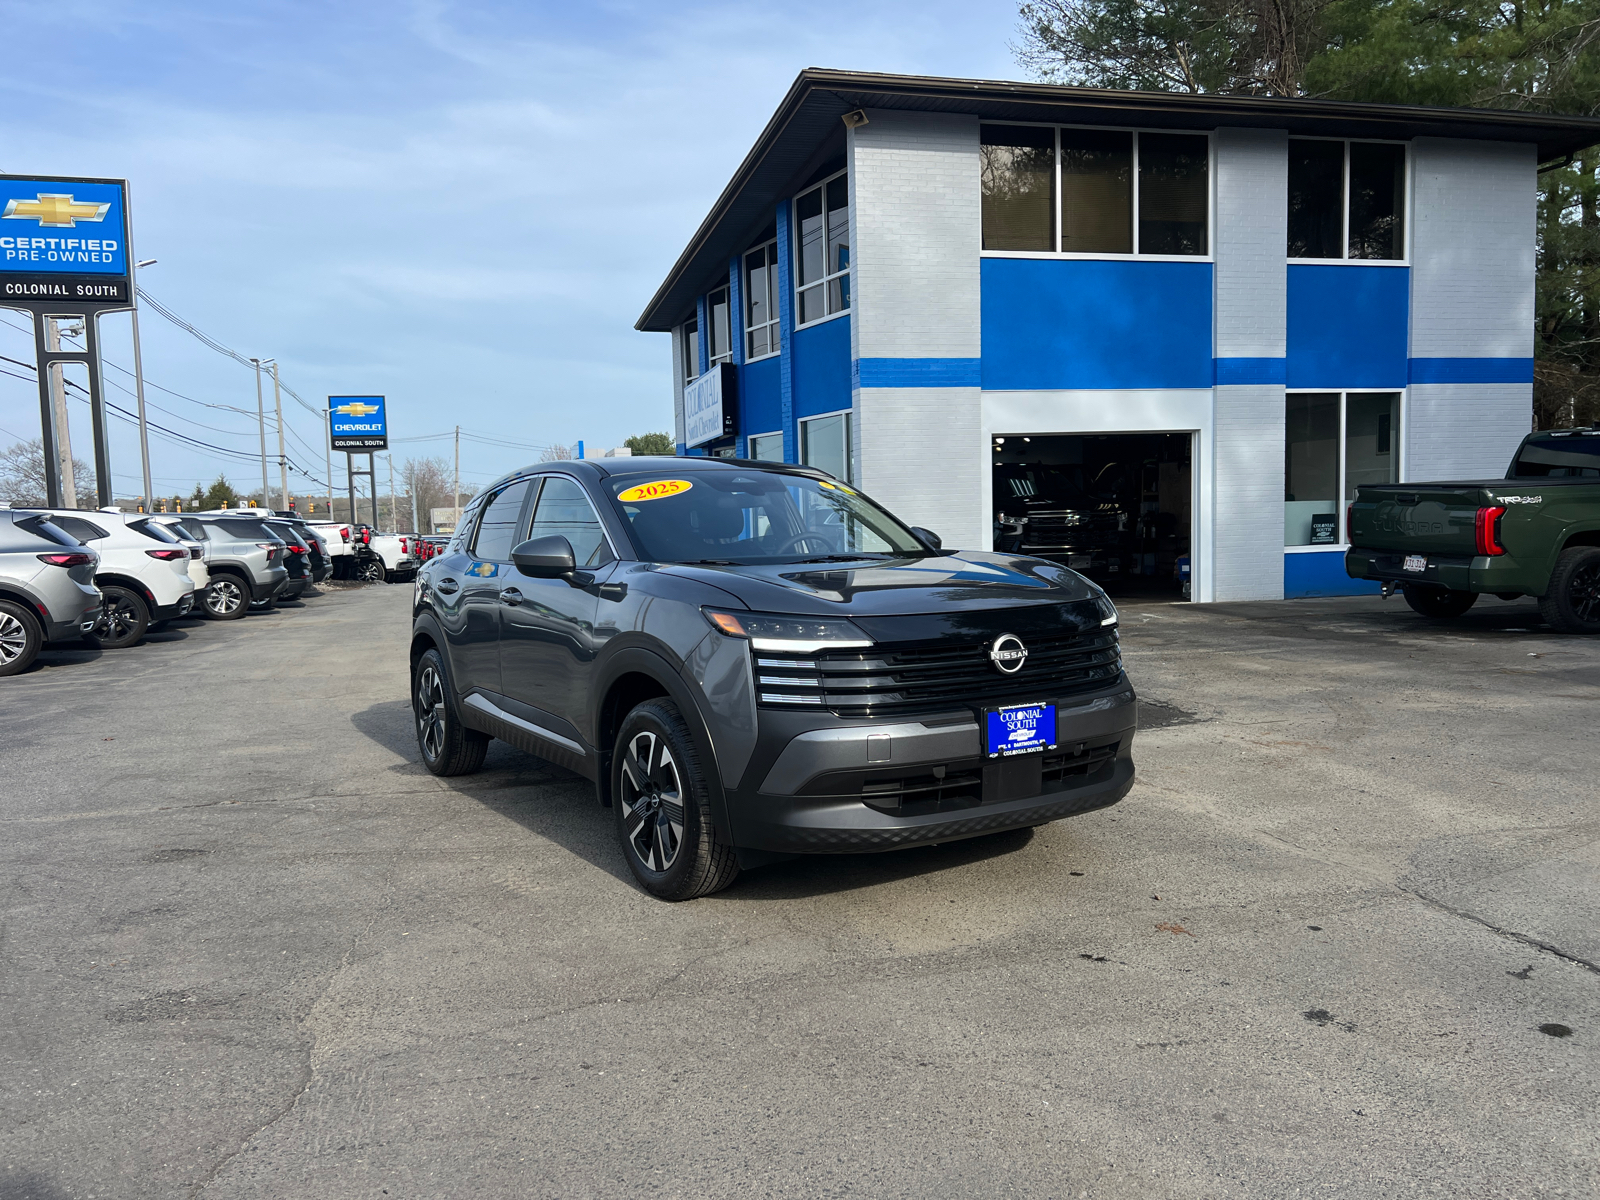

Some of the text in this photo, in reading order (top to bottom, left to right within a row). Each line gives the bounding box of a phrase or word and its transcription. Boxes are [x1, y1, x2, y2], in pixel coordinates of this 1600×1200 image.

[0, 237, 118, 251] CERTIFIED
[6, 250, 113, 263] PRE-OWNED
[5, 283, 118, 296] COLONIAL SOUTH
[634, 481, 680, 500] 2025
[1372, 519, 1444, 534] TUNDRA
[991, 649, 1028, 660] NISSAN
[1000, 709, 1043, 722] COLONIAL
[1007, 719, 1037, 731] SOUTH
